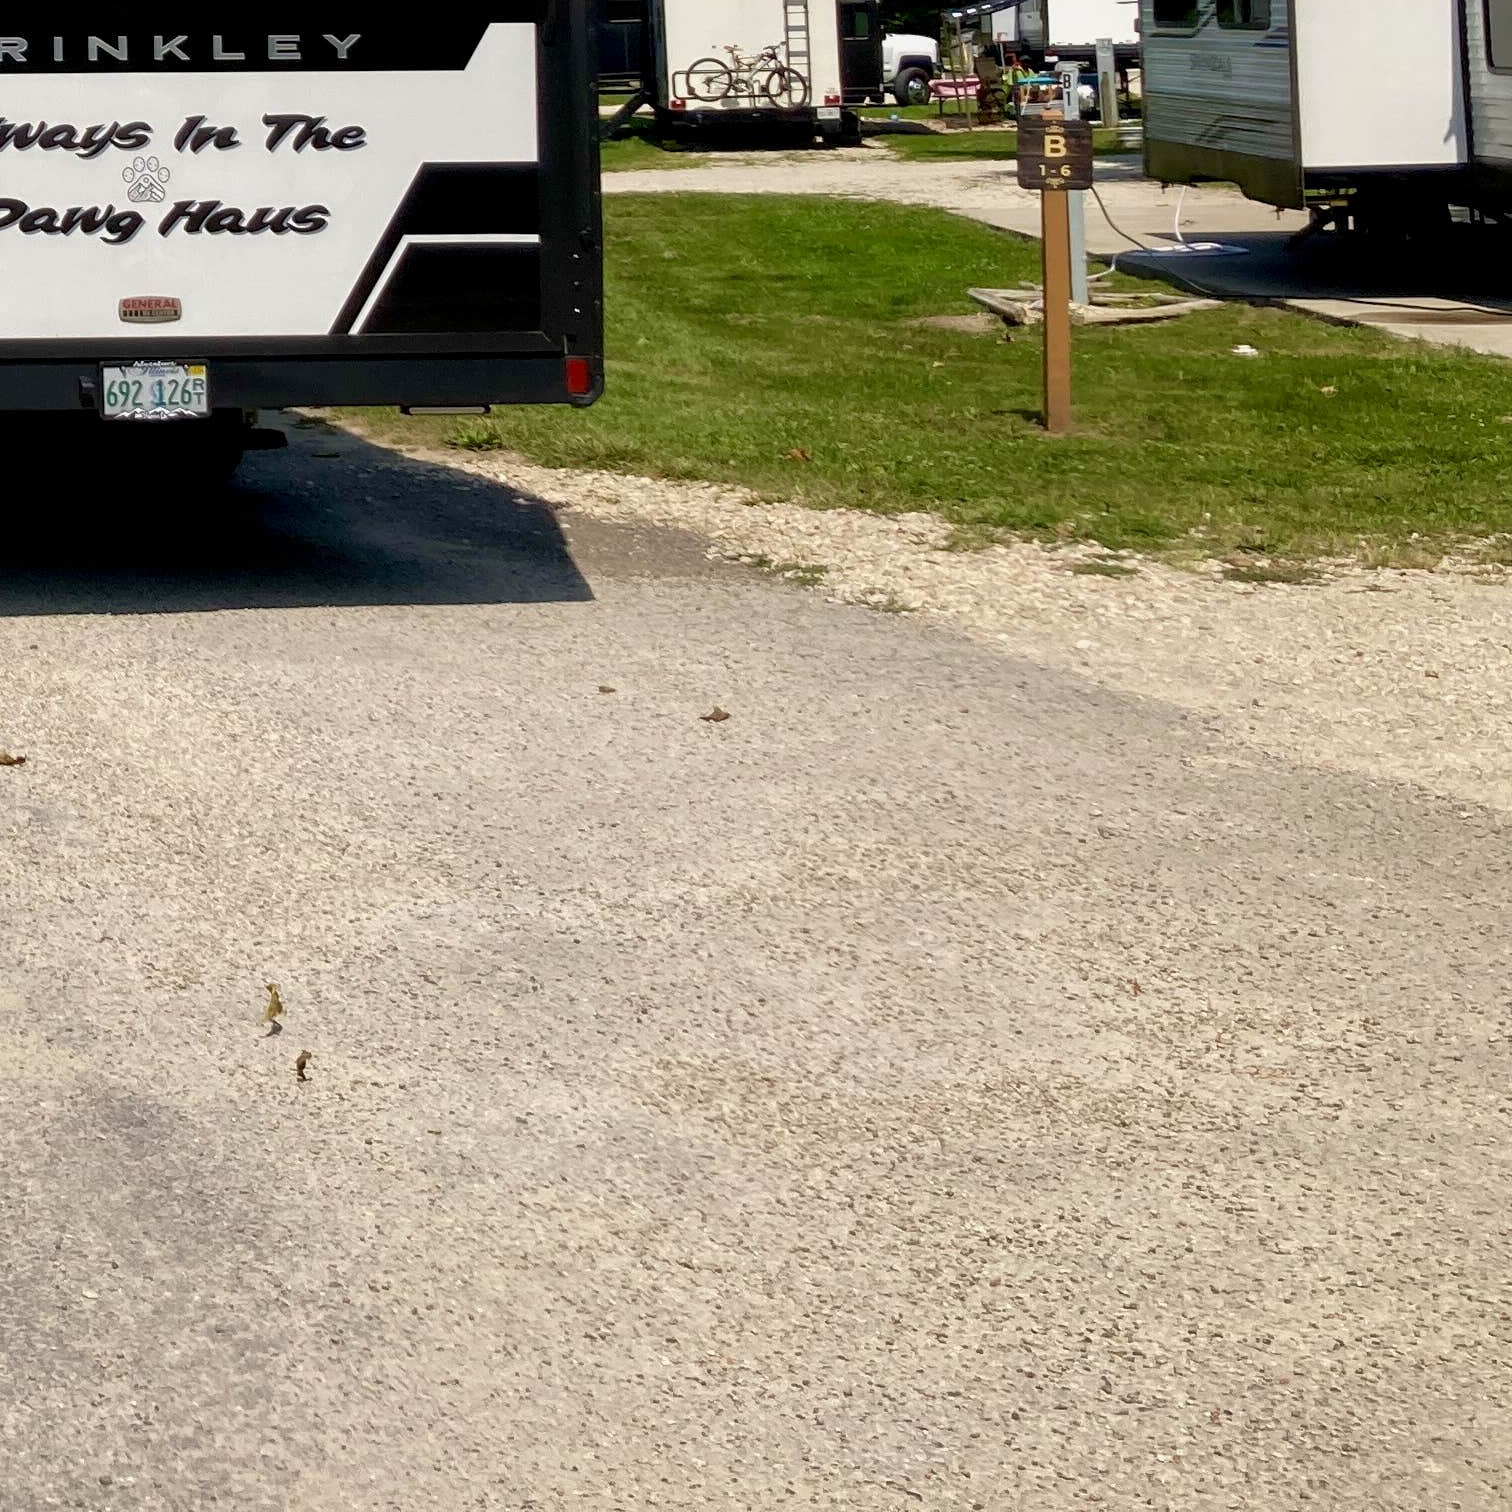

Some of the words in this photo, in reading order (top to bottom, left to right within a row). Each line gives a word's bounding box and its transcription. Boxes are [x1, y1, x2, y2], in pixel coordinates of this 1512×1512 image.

[174, 114, 243, 155] In
[261, 112, 369, 153] The
[1044, 134, 1068, 158] B
[157, 199, 332, 236] Haus
[122, 298, 177, 309] GENERAL
[107, 379, 143, 408] 692
[151, 378, 192, 407] 126
